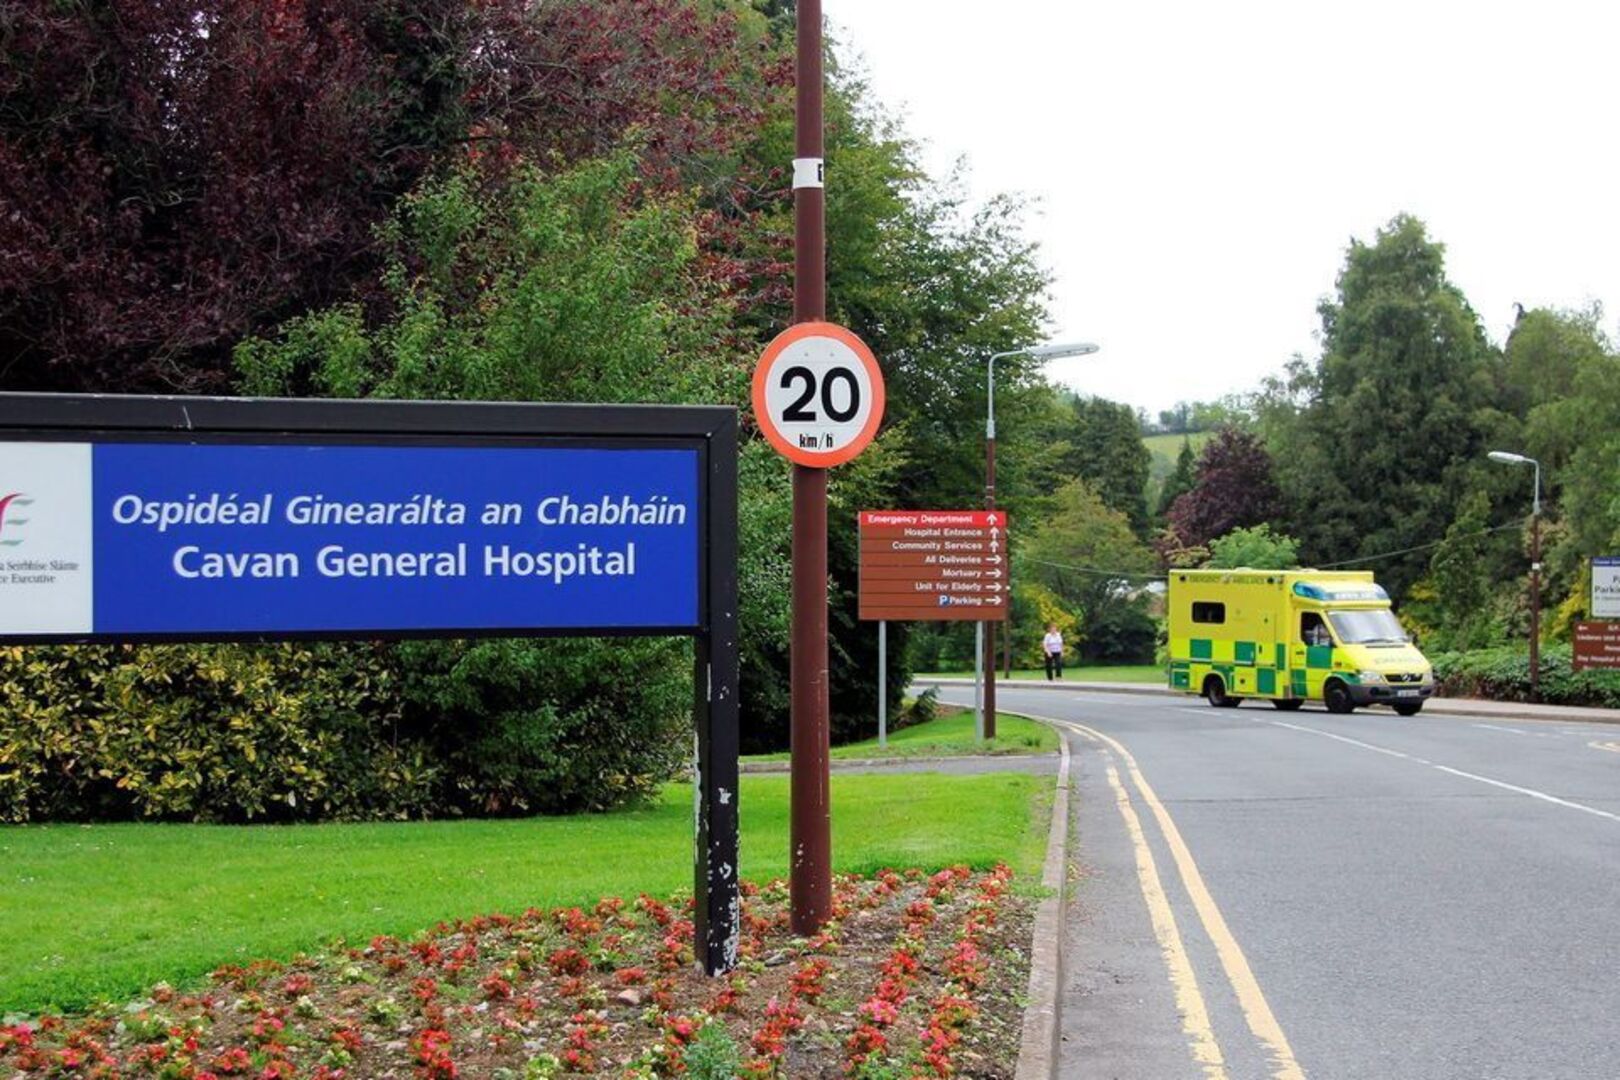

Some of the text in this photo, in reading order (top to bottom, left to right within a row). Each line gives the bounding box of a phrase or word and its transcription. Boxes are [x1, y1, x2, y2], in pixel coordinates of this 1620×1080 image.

[780, 366, 860, 423] 20
[799, 432, 834, 450] km/h
[112, 493, 687, 532] Ospidéal Ginearálta an Chabháin
[868, 514, 973, 525] Emergency Department
[904, 527, 982, 537] Hospital Entrance
[892, 541, 982, 551] Community Services
[173, 542, 635, 584] Cavan General Hospital
[925, 555, 982, 564] All Deliveries
[942, 569, 982, 578] Mortuary
[915, 583, 982, 592] Unit for Elderly
[949, 596, 983, 606] Parking
